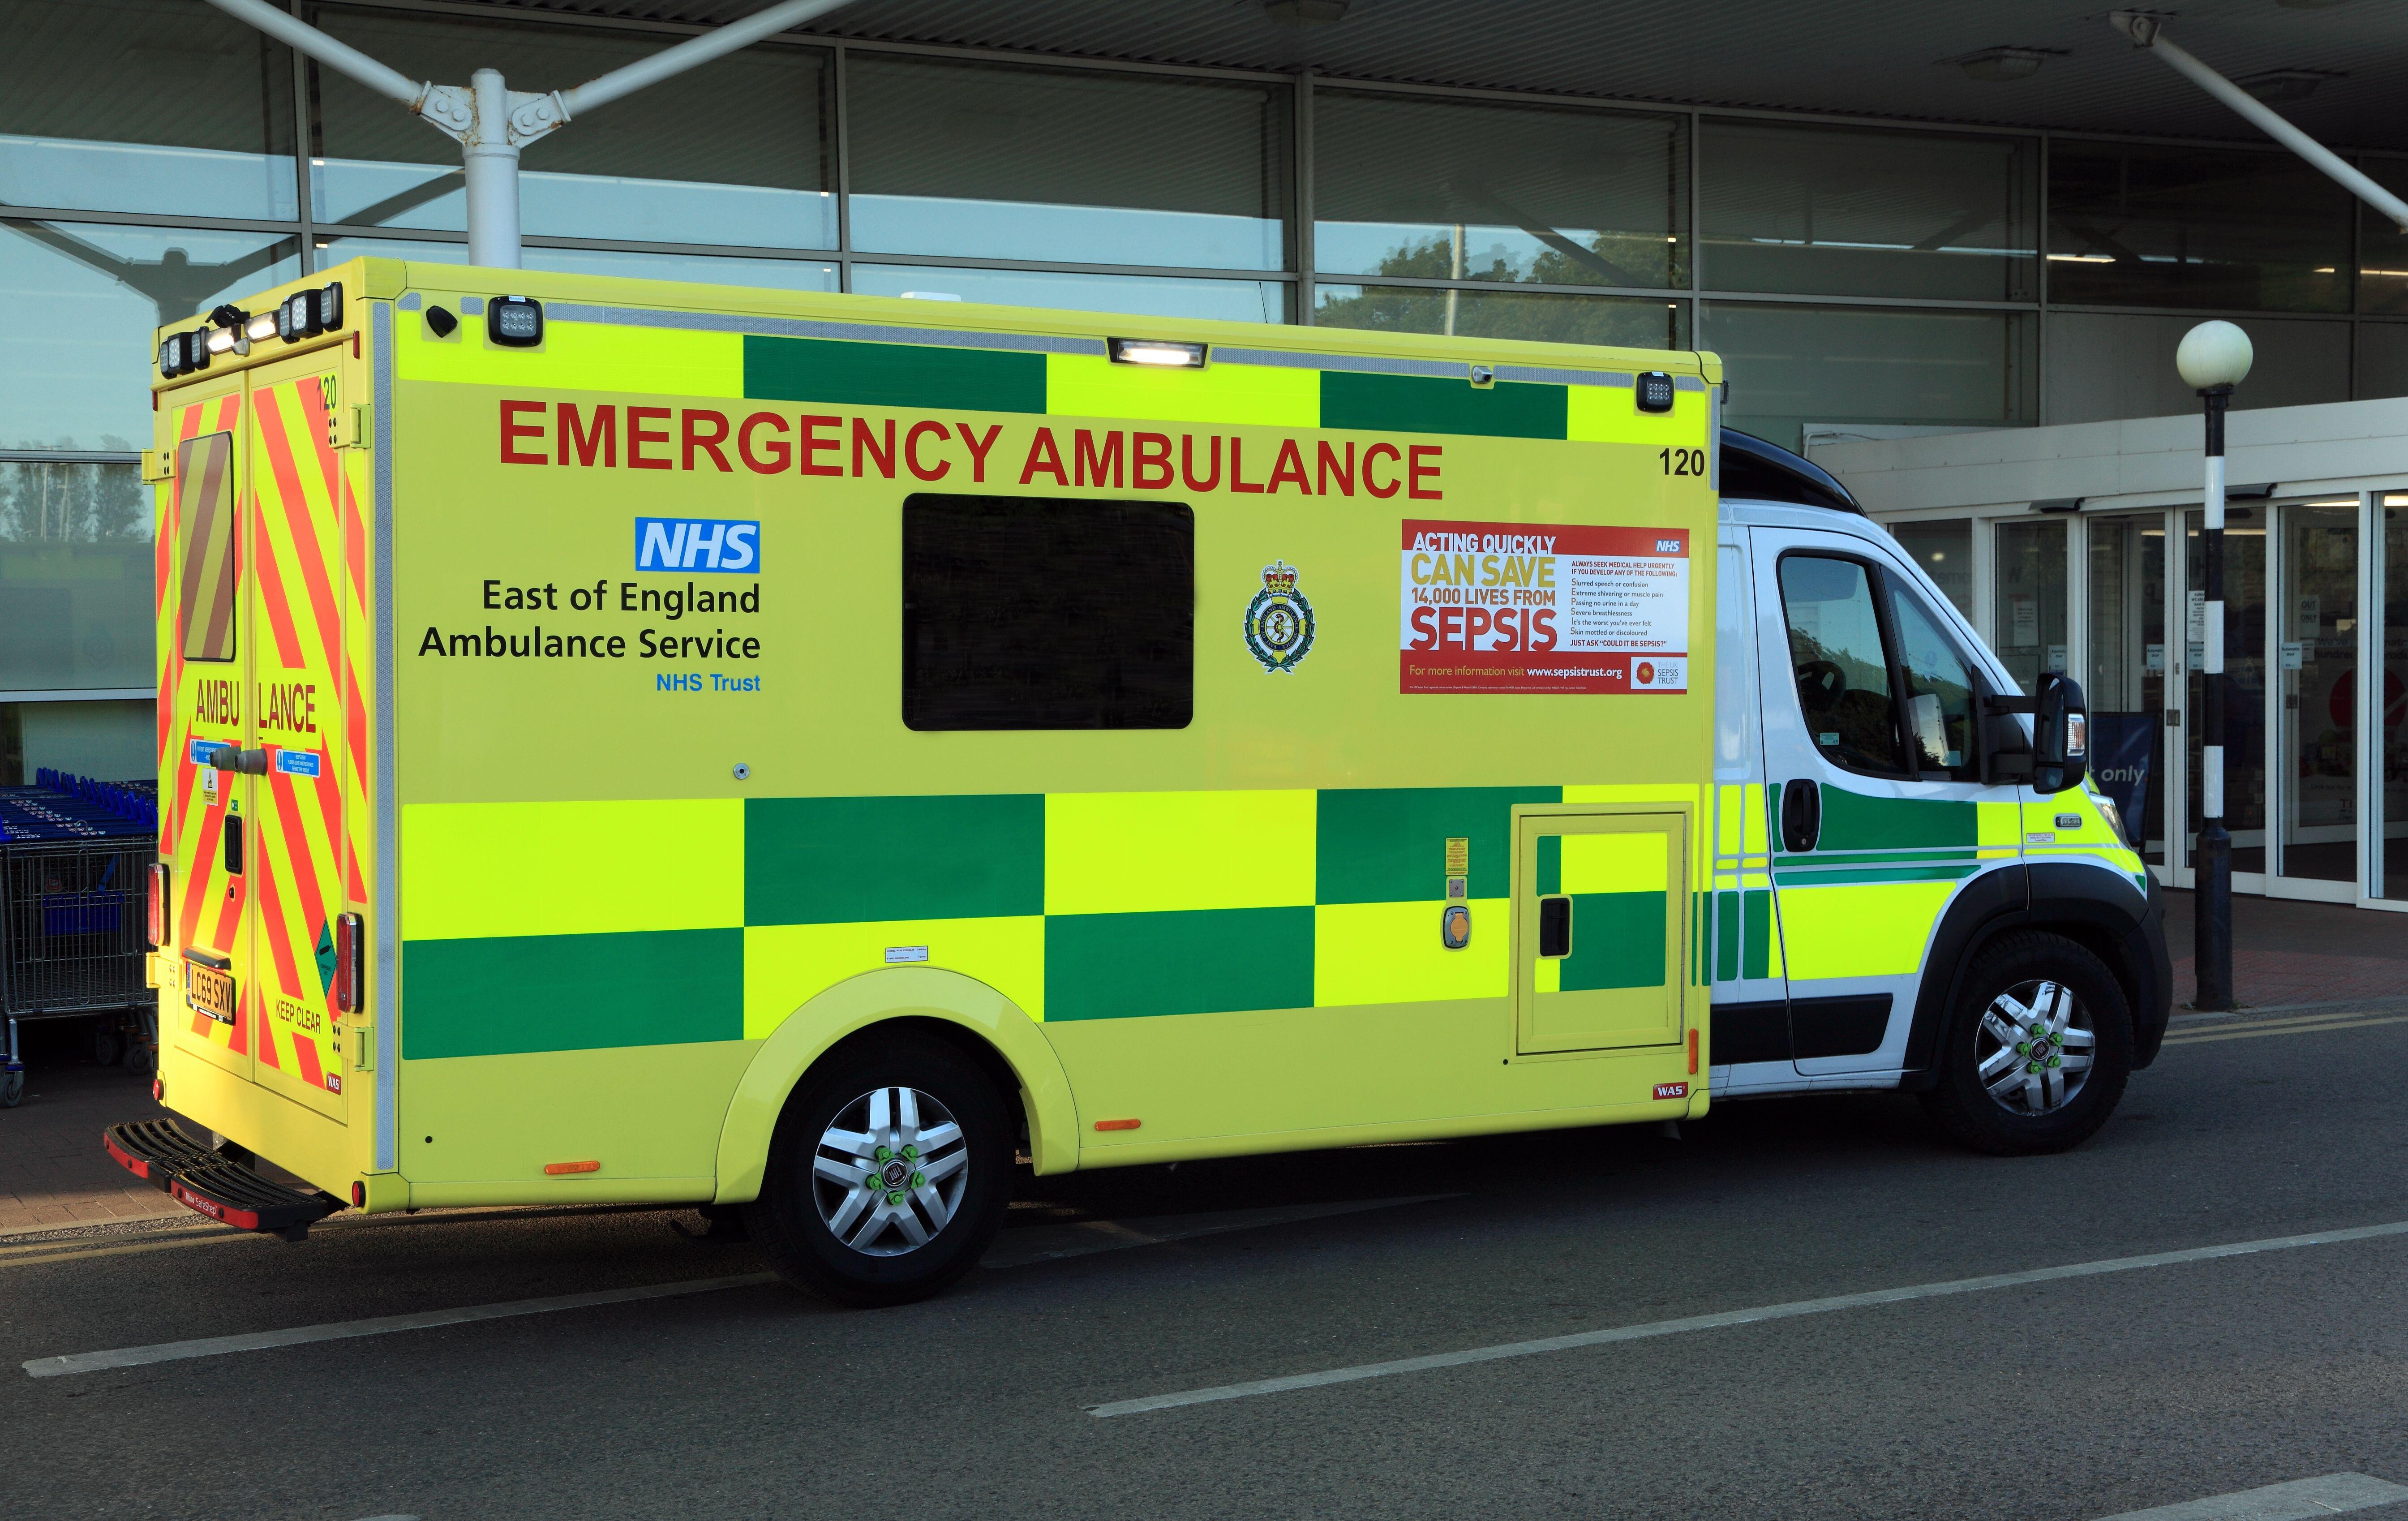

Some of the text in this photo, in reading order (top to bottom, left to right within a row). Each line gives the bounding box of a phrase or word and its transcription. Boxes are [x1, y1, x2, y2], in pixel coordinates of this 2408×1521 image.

[318, 374, 336, 412] 120
[500, 401, 1443, 501] EMERGENCY AMBULANCE
[1660, 448, 1704, 476] 120
[640, 522, 757, 569] NHS
[1412, 532, 1556, 554] ACTING QUICKLY
[1657, 541, 1680, 551] NHS
[1412, 553, 1555, 587] CAN SAVE
[484, 580, 760, 620] East of England
[1412, 588, 1555, 606] 14,000 LIVES FROM
[1571, 588, 1596, 596] Extreme
[1571, 598, 1592, 607] Passing
[2301, 601, 2316, 609] OUT
[1261, 607, 1276, 628] ENGLAND
[1279, 606, 1299, 630] AMBULANCE
[1409, 606, 1557, 651] SEPSIS
[1571, 627, 1583, 635] Skin
[418, 626, 760, 658] Ambulance Service
[1265, 640, 1277, 649] EAST
[1282, 632, 1298, 649] SERVICE
[657, 673, 760, 692] NHS Trust
[1410, 666, 1622, 679] For more information visit www.sepsistrust.org
[1657, 669, 1678, 677] SEPSIS
[196, 679, 316, 733] AMBU LANCE
[192, 969, 211, 1005] LC69
[215, 979, 230, 1013] SXV
[276, 998, 321, 1034] KEEP CLEAR
[328, 1076, 339, 1089] WAS
[889, 1166, 902, 1181] FIAT
[185, 1191, 194, 1204] Rhino
